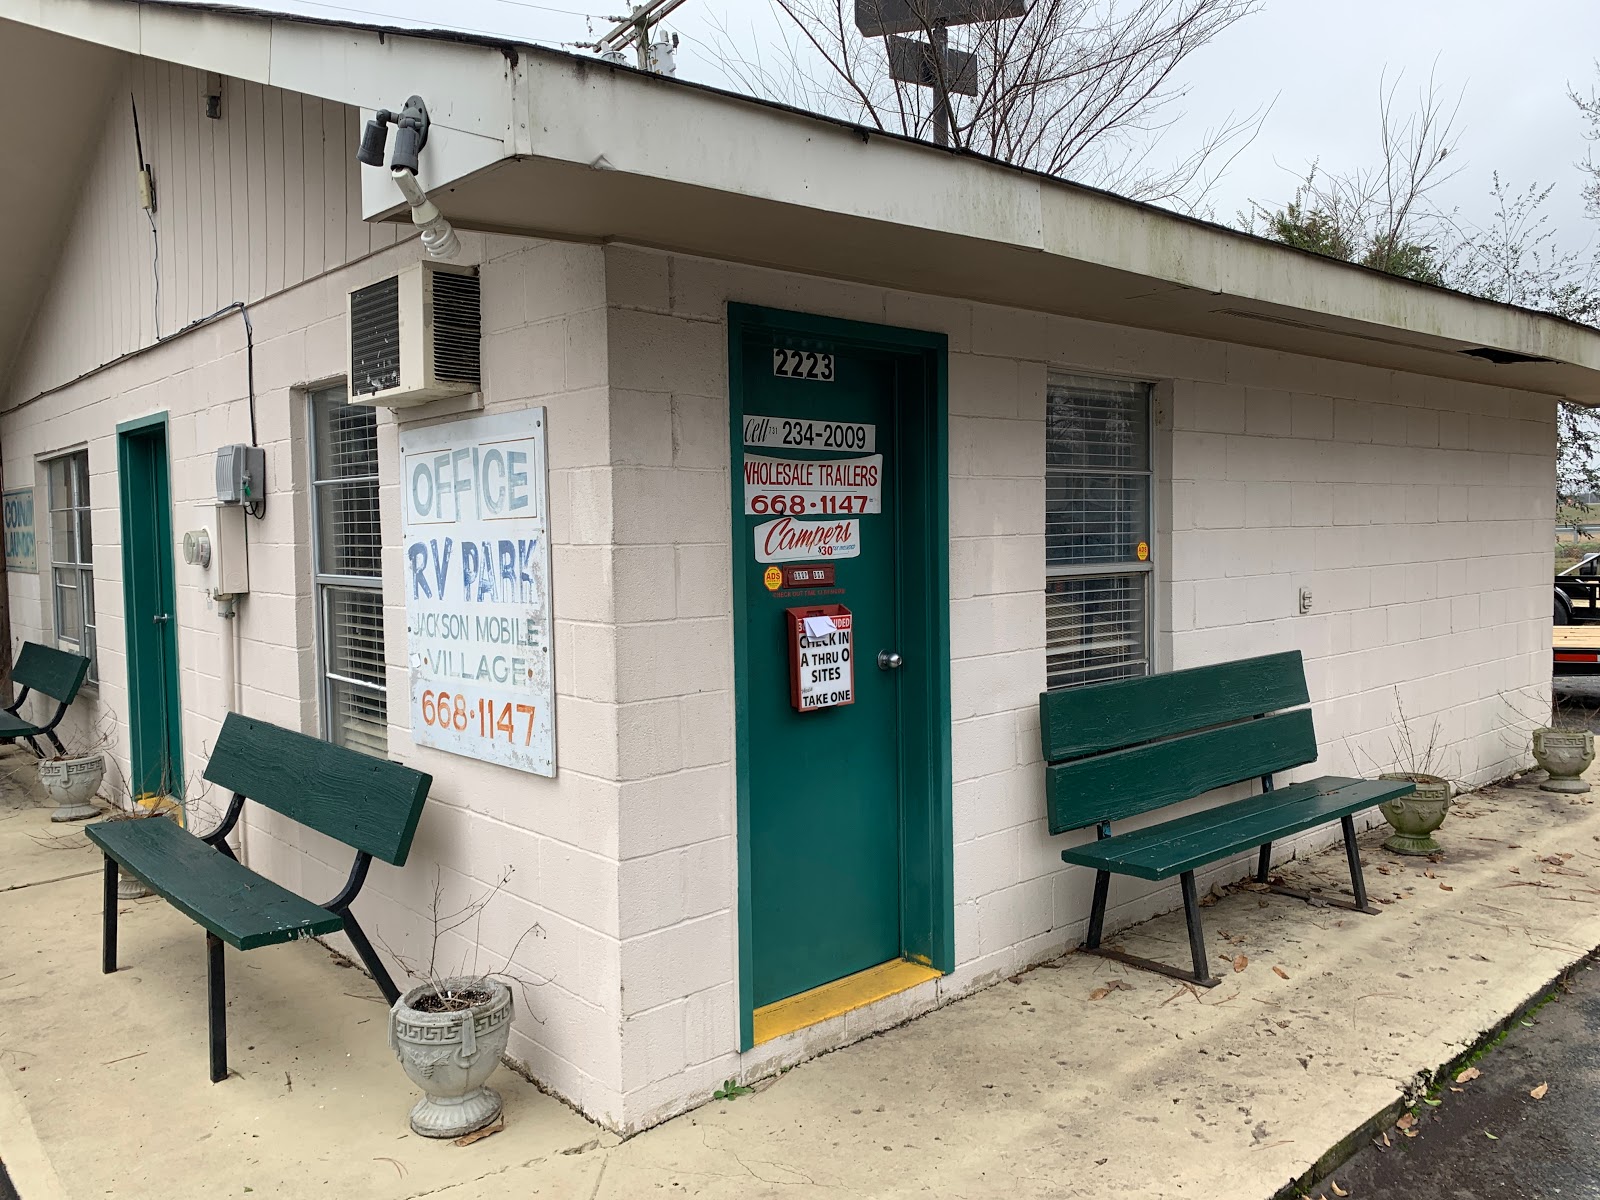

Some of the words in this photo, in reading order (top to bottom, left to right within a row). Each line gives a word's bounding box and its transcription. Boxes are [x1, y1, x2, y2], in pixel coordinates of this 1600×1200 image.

[775, 349, 833, 380] 2223
[744, 418, 770, 443] Cell
[782, 421, 866, 449] 234-2009
[412, 447, 529, 522] OFFICE
[818, 464, 878, 488] TRAILERS
[764, 517, 852, 556] Campers
[408, 536, 453, 600] RV
[461, 539, 537, 604] PARK
[766, 572, 781, 580] ADS
[413, 612, 469, 641] JACKSON
[476, 615, 539, 647] MOBILE
[838, 631, 850, 645] IN
[427, 648, 527, 686] VILLAGE
[800, 652, 809, 668] A
[812, 651, 839, 666] THRU
[841, 647, 850, 662] O
[811, 666, 841, 683] SITES
[803, 693, 828, 707] TAKE
[830, 689, 851, 703] ONE
